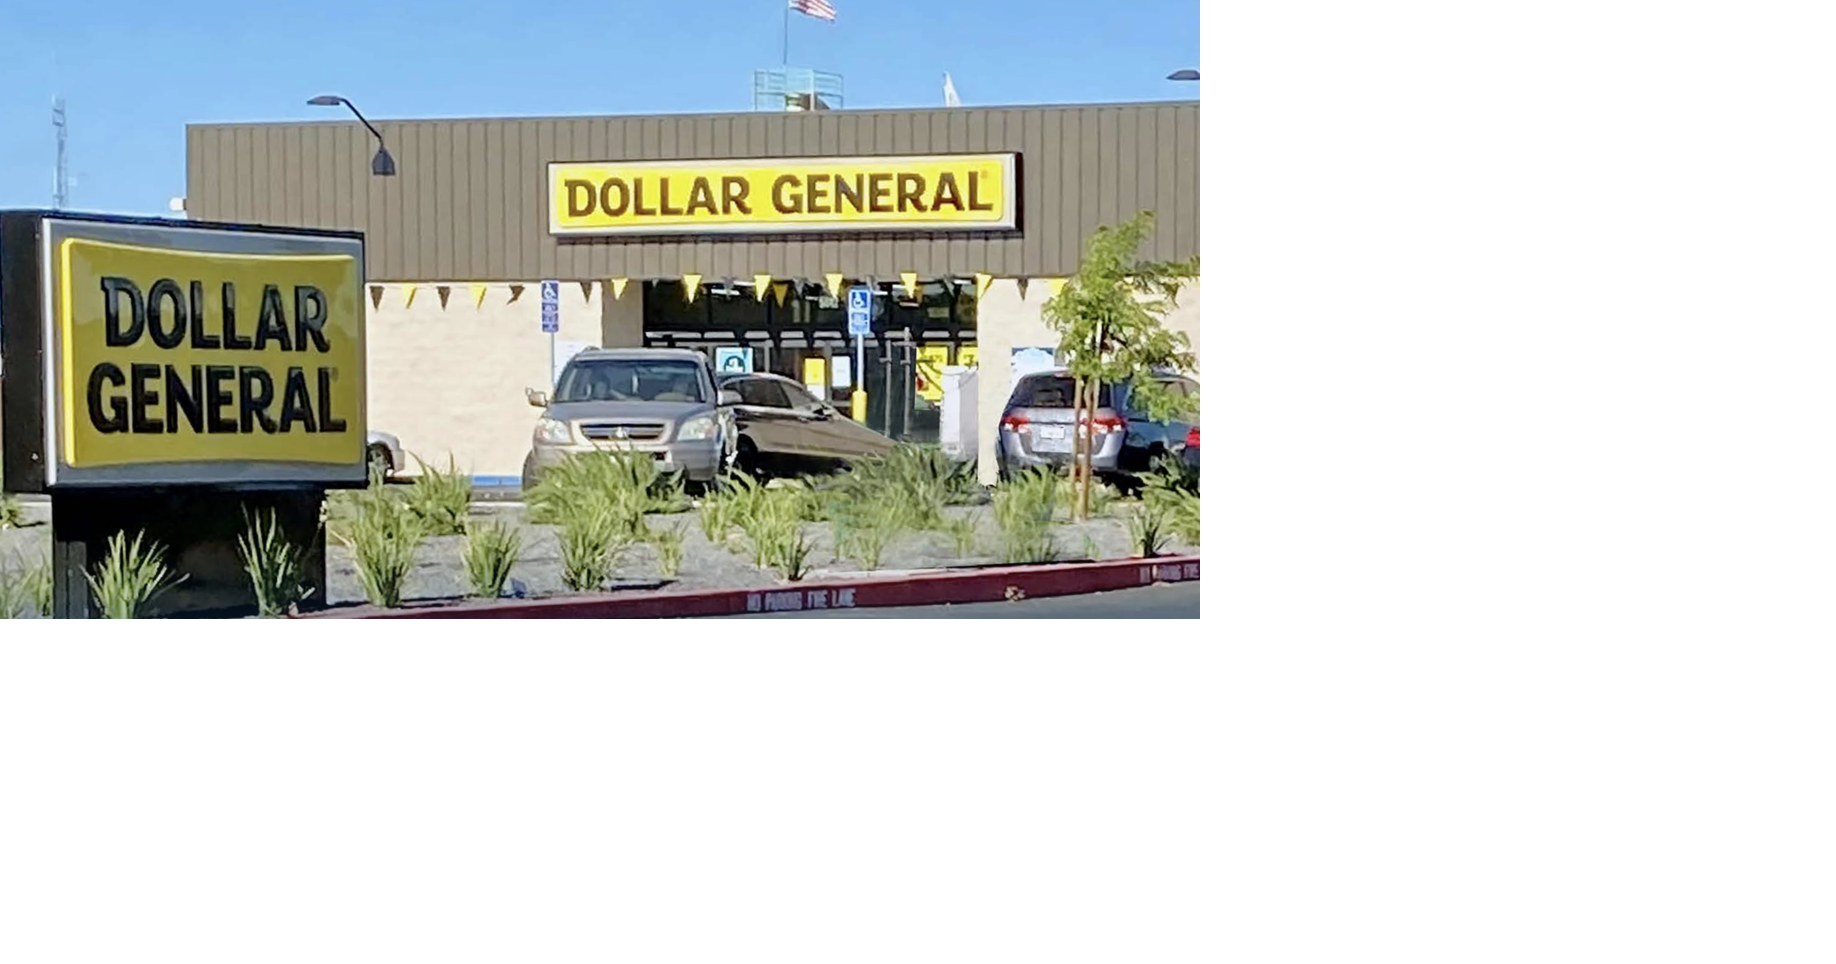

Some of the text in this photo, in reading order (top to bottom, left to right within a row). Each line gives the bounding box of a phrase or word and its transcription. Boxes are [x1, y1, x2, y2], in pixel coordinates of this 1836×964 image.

[564, 171, 994, 218] DOLLAR GENERAL
[101, 276, 330, 353] DOLLAR
[87, 362, 347, 434] GENERAL
